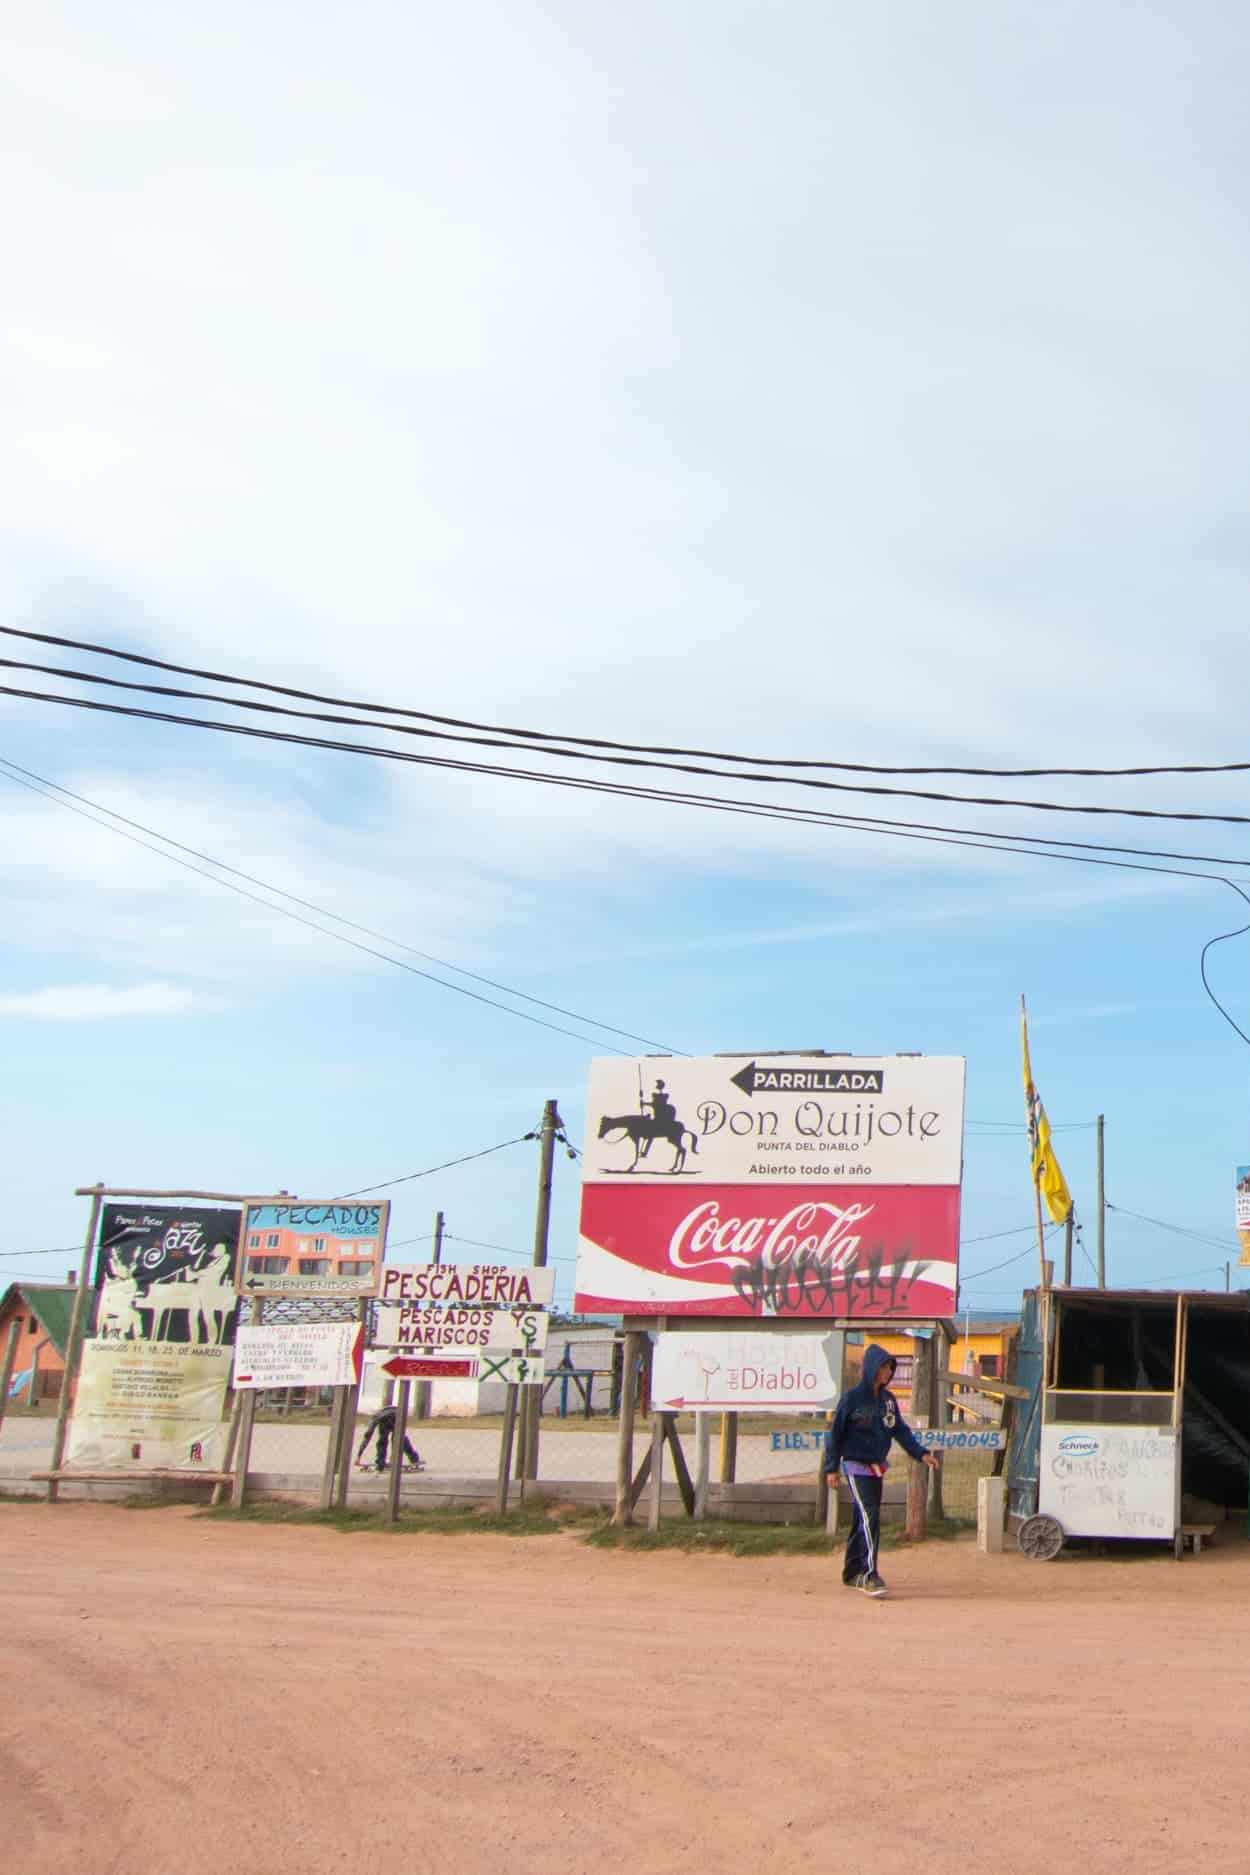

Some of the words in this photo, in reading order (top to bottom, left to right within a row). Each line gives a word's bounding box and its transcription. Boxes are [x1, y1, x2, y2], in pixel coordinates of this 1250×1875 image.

[753, 1072, 879, 1090] PARRILLADA
[696, 1100, 778, 1136] Don
[795, 1101, 941, 1145] Quijote
[757, 1142, 792, 1151] PUNTA
[796, 1142, 816, 1151] DEL
[819, 1142, 860, 1151] DIABLO
[749, 1163, 797, 1176] Abierto
[799, 1164, 829, 1175] todo
[833, 1164, 845, 1175] el
[848, 1164, 873, 1176] año
[251, 1207, 263, 1224] 7
[274, 1205, 380, 1226] PECADOS
[331, 1225, 379, 1235] HOUSES
[669, 1200, 874, 1269] Coca-Cola
[427, 1264, 457, 1275] FISH
[473, 1264, 507, 1276] SHOP
[269, 1279, 361, 1290] BIENVENIDOS
[383, 1270, 532, 1302] PESCADERIA
[401, 1309, 494, 1326] PESCADOS
[398, 1326, 490, 1346] MARISCOS
[741, 1366, 818, 1391] Diablo
[1058, 1440, 1099, 1450] Schneck
